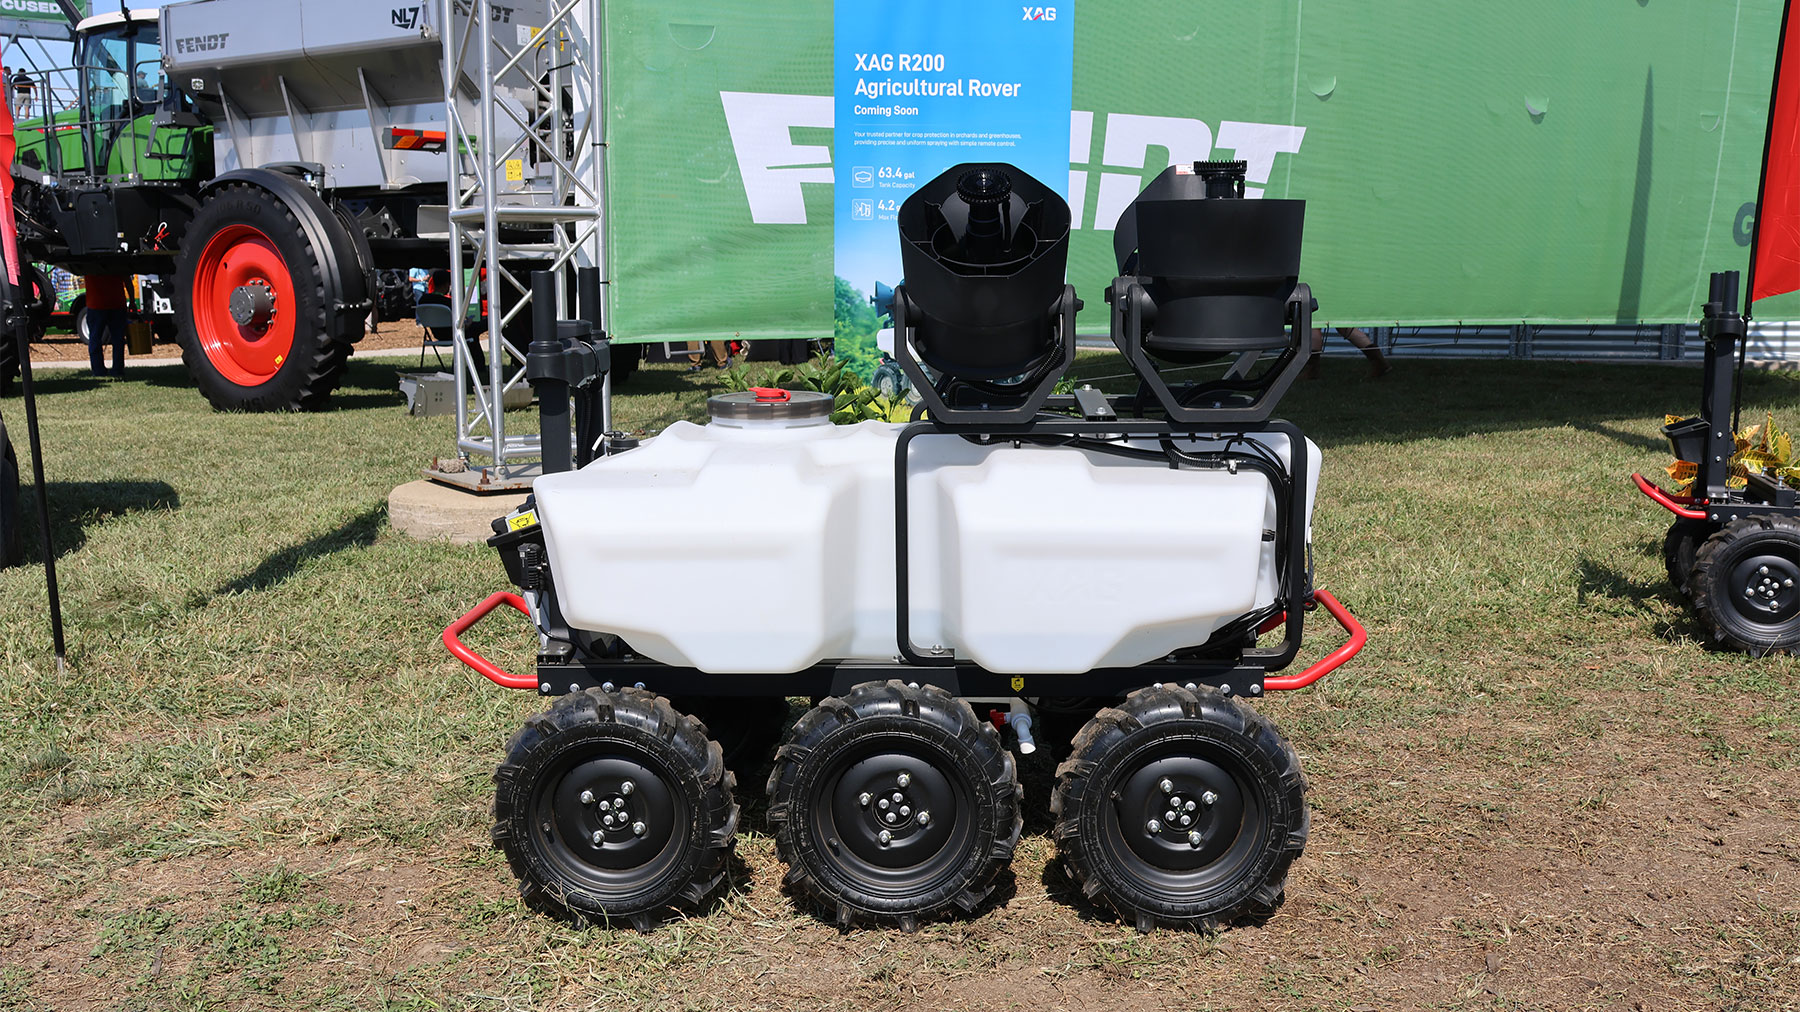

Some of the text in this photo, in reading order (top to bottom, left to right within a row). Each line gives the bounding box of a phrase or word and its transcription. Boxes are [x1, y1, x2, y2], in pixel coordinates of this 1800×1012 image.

[391, 6, 420, 29] NL7
[1022, 6, 1057, 21] XAG
[175, 32, 230, 54] FENDT
[854, 53, 945, 72] XAG R200
[854, 78, 1022, 100] Agricultural Rover
[854, 104, 919, 117] Coming Soon
[885, 131, 903, 139] partner
[720, 90, 1307, 231] FDT
[878, 167, 915, 180] 63.4 gal
[892, 182, 916, 190] Capacity
[877, 200, 896, 211] 4.2
